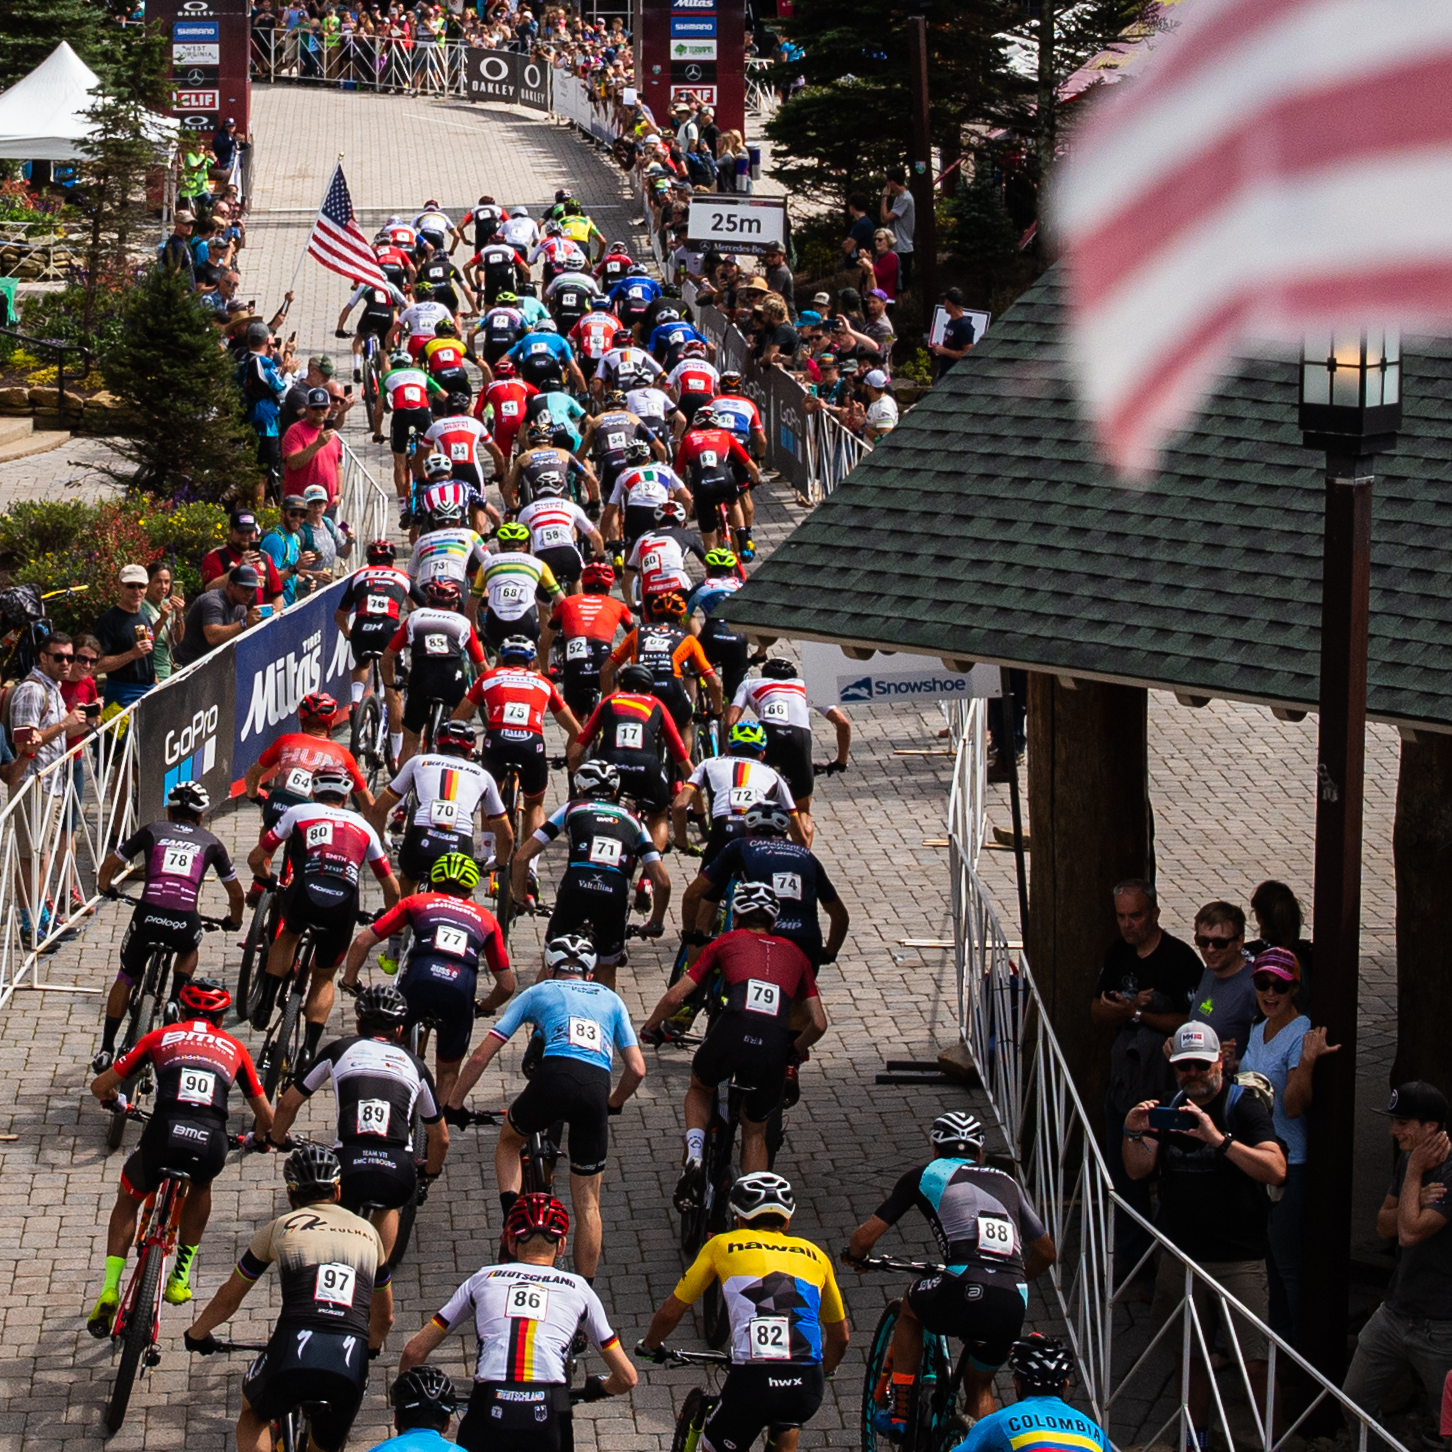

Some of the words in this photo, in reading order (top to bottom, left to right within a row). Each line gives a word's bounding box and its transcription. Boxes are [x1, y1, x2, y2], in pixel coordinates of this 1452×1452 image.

[472, 80, 514, 97] OAKLEY
[520, 88, 545, 104] OAKLEY
[181, 94, 213, 106] CLIF
[711, 213, 761, 234] 25m
[714, 243, 766, 254] Mercedes-Be
[611, 435, 623, 444] 54
[453, 446, 465, 455] 34
[545, 531, 559, 540] 58
[433, 560, 445, 570] 73
[644, 555, 656, 567] 60
[502, 588, 517, 598] 68
[371, 599, 385, 608] 76
[362, 623, 383, 631] BH
[301, 629, 322, 653] TIRES
[429, 638, 444, 647] 85
[569, 642, 583, 654] 52
[240, 645, 322, 742] Mitas
[874, 677, 967, 695] Snowshoe
[508, 707, 525, 719] 75
[767, 704, 785, 715] 66
[165, 704, 219, 766] GoPro
[501, 728, 529, 738] ITALIA
[621, 729, 638, 740] 17
[292, 774, 311, 789] 64
[734, 790, 753, 802] 72
[436, 804, 454, 817] 70
[310, 826, 328, 840] 80
[158, 838, 201, 853] SANTA
[597, 842, 615, 856] 71
[169, 852, 188, 867] 78
[325, 852, 347, 862] SMITH
[309, 882, 344, 897] NORCO
[578, 879, 614, 893] Valtellina
[777, 877, 798, 891] 74
[144, 914, 188, 930] prologo
[442, 930, 462, 945] 77
[753, 985, 774, 1004] 79
[576, 1023, 596, 1040] 83
[161, 1029, 238, 1058] BMC
[161, 1040, 227, 1056] SWITZERLAND
[185, 1076, 208, 1094] 90
[362, 1105, 385, 1123] 89
[173, 1123, 210, 1142] BMC
[985, 1221, 1008, 1242] 88
[323, 1269, 350, 1291] 97
[492, 1270, 576, 1289] DEUTSCHLAND
[514, 1290, 541, 1309] 86
[757, 1325, 784, 1347] 82
[768, 1376, 803, 1388] hwx
[1008, 1414, 1102, 1441] COLOMBIA
